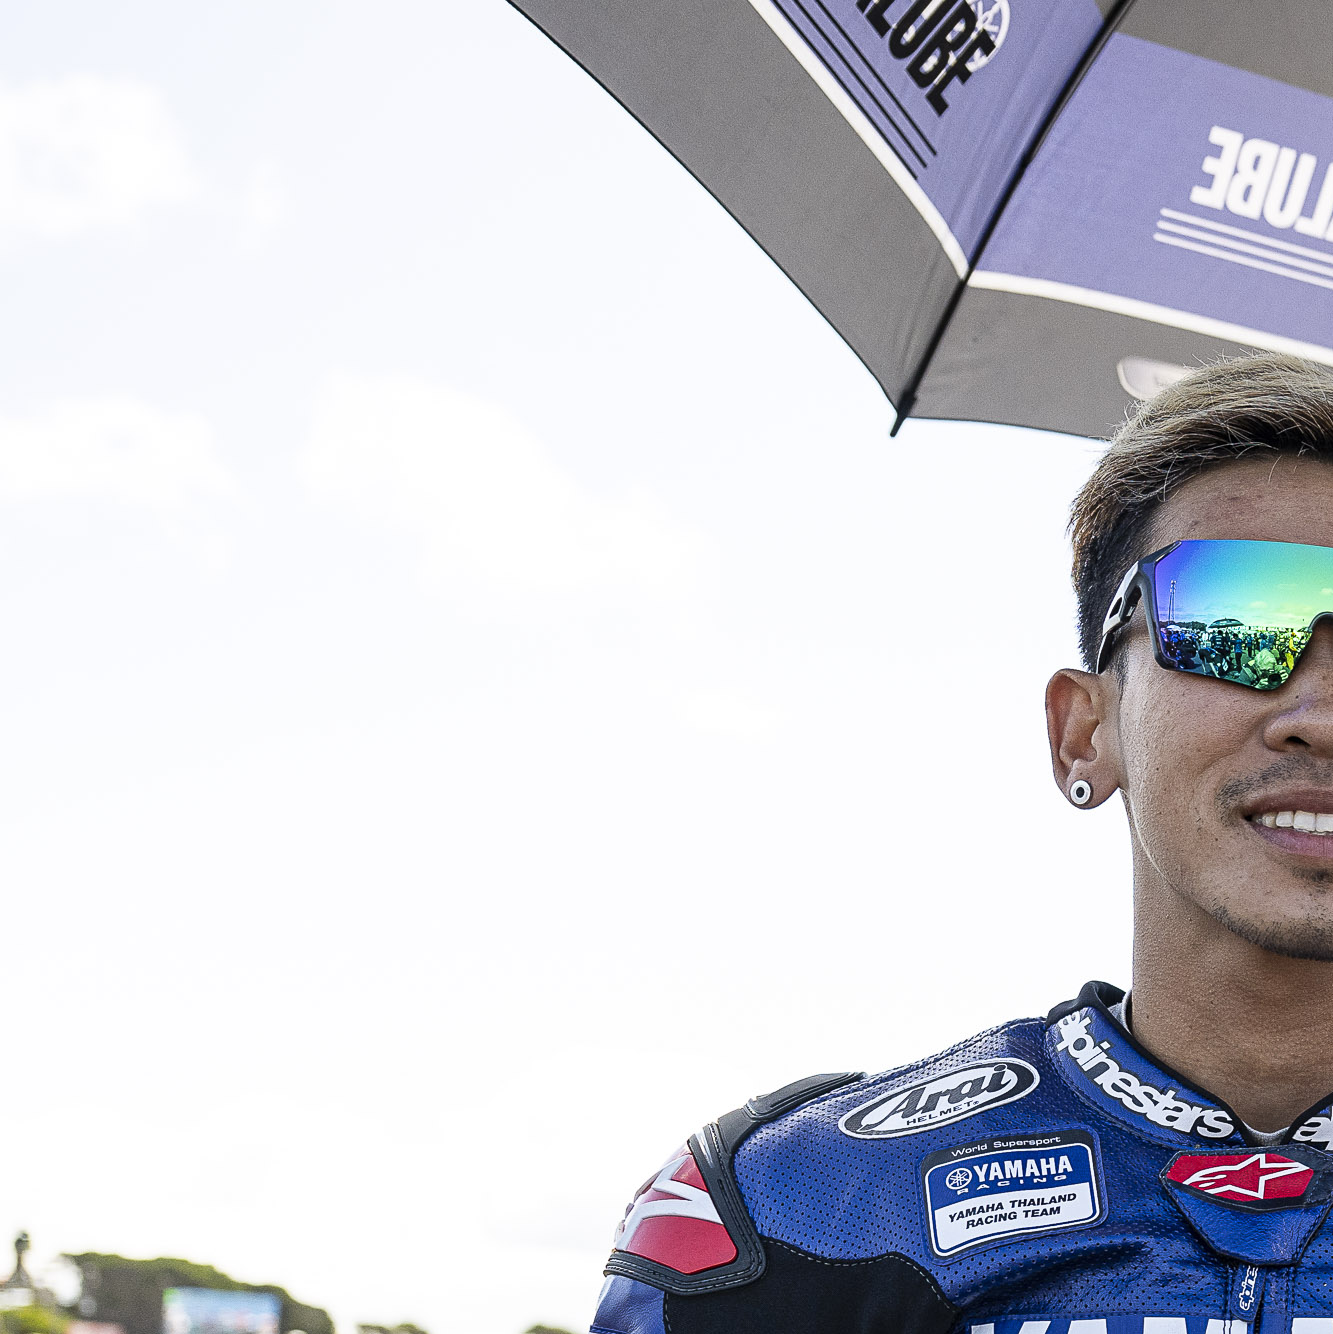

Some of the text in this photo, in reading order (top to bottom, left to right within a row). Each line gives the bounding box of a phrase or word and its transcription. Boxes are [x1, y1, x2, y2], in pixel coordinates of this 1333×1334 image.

[856, 0, 997, 117] LUBE
[1056, 1009, 1235, 1139] alpinestars
[856, 1062, 1013, 1133] Arai
[905, 1100, 972, 1127] HELMET
[951, 1135, 1062, 1158] World Supersport
[973, 1154, 1073, 1184] YAMAHA
[957, 1173, 1068, 1196] RACING
[948, 1192, 1078, 1223] YAMAHA THAILAND
[965, 1205, 1062, 1230] RACING TEAM
